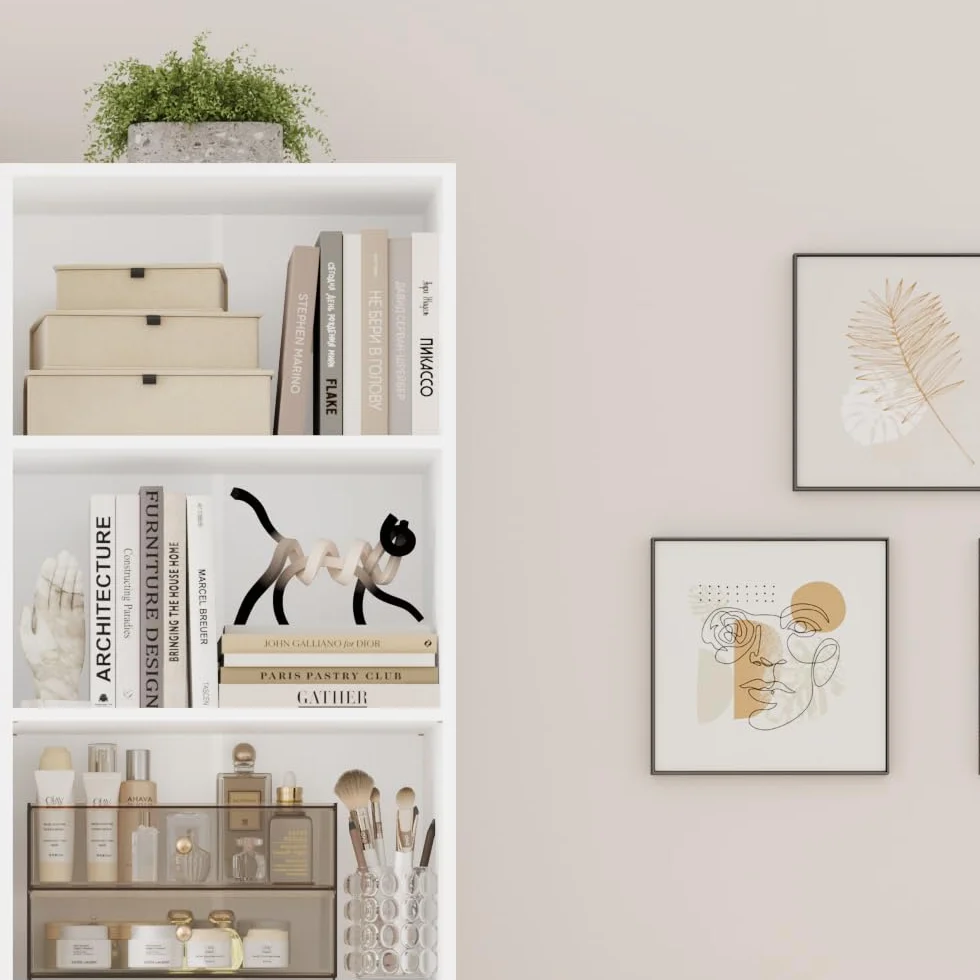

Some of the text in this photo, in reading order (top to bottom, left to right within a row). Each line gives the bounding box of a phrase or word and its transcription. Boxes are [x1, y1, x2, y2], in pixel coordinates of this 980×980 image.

[289, 292, 309, 394] STEPHEN MARINO
[367, 290, 384, 412] НЕ БЕРИ В ГОЛОВУ
[419, 337, 434, 398] ПИКАССО
[324, 378, 338, 417] FLAKE
[95, 516, 111, 683] ARCHITECTURE
[122, 548, 134, 602] Constructing
[144, 490, 160, 708] FURNITURE DESIGN
[169, 541, 180, 662] BRINGING THE HOUSE HOME
[197, 568, 208, 645] MARCEL BREUER
[260, 671, 403, 681] PARIS PASTRY CLUB
[263, 638, 381, 649] JOHN GALLIANO for DIOR
[297, 690, 368, 706] GATHER
